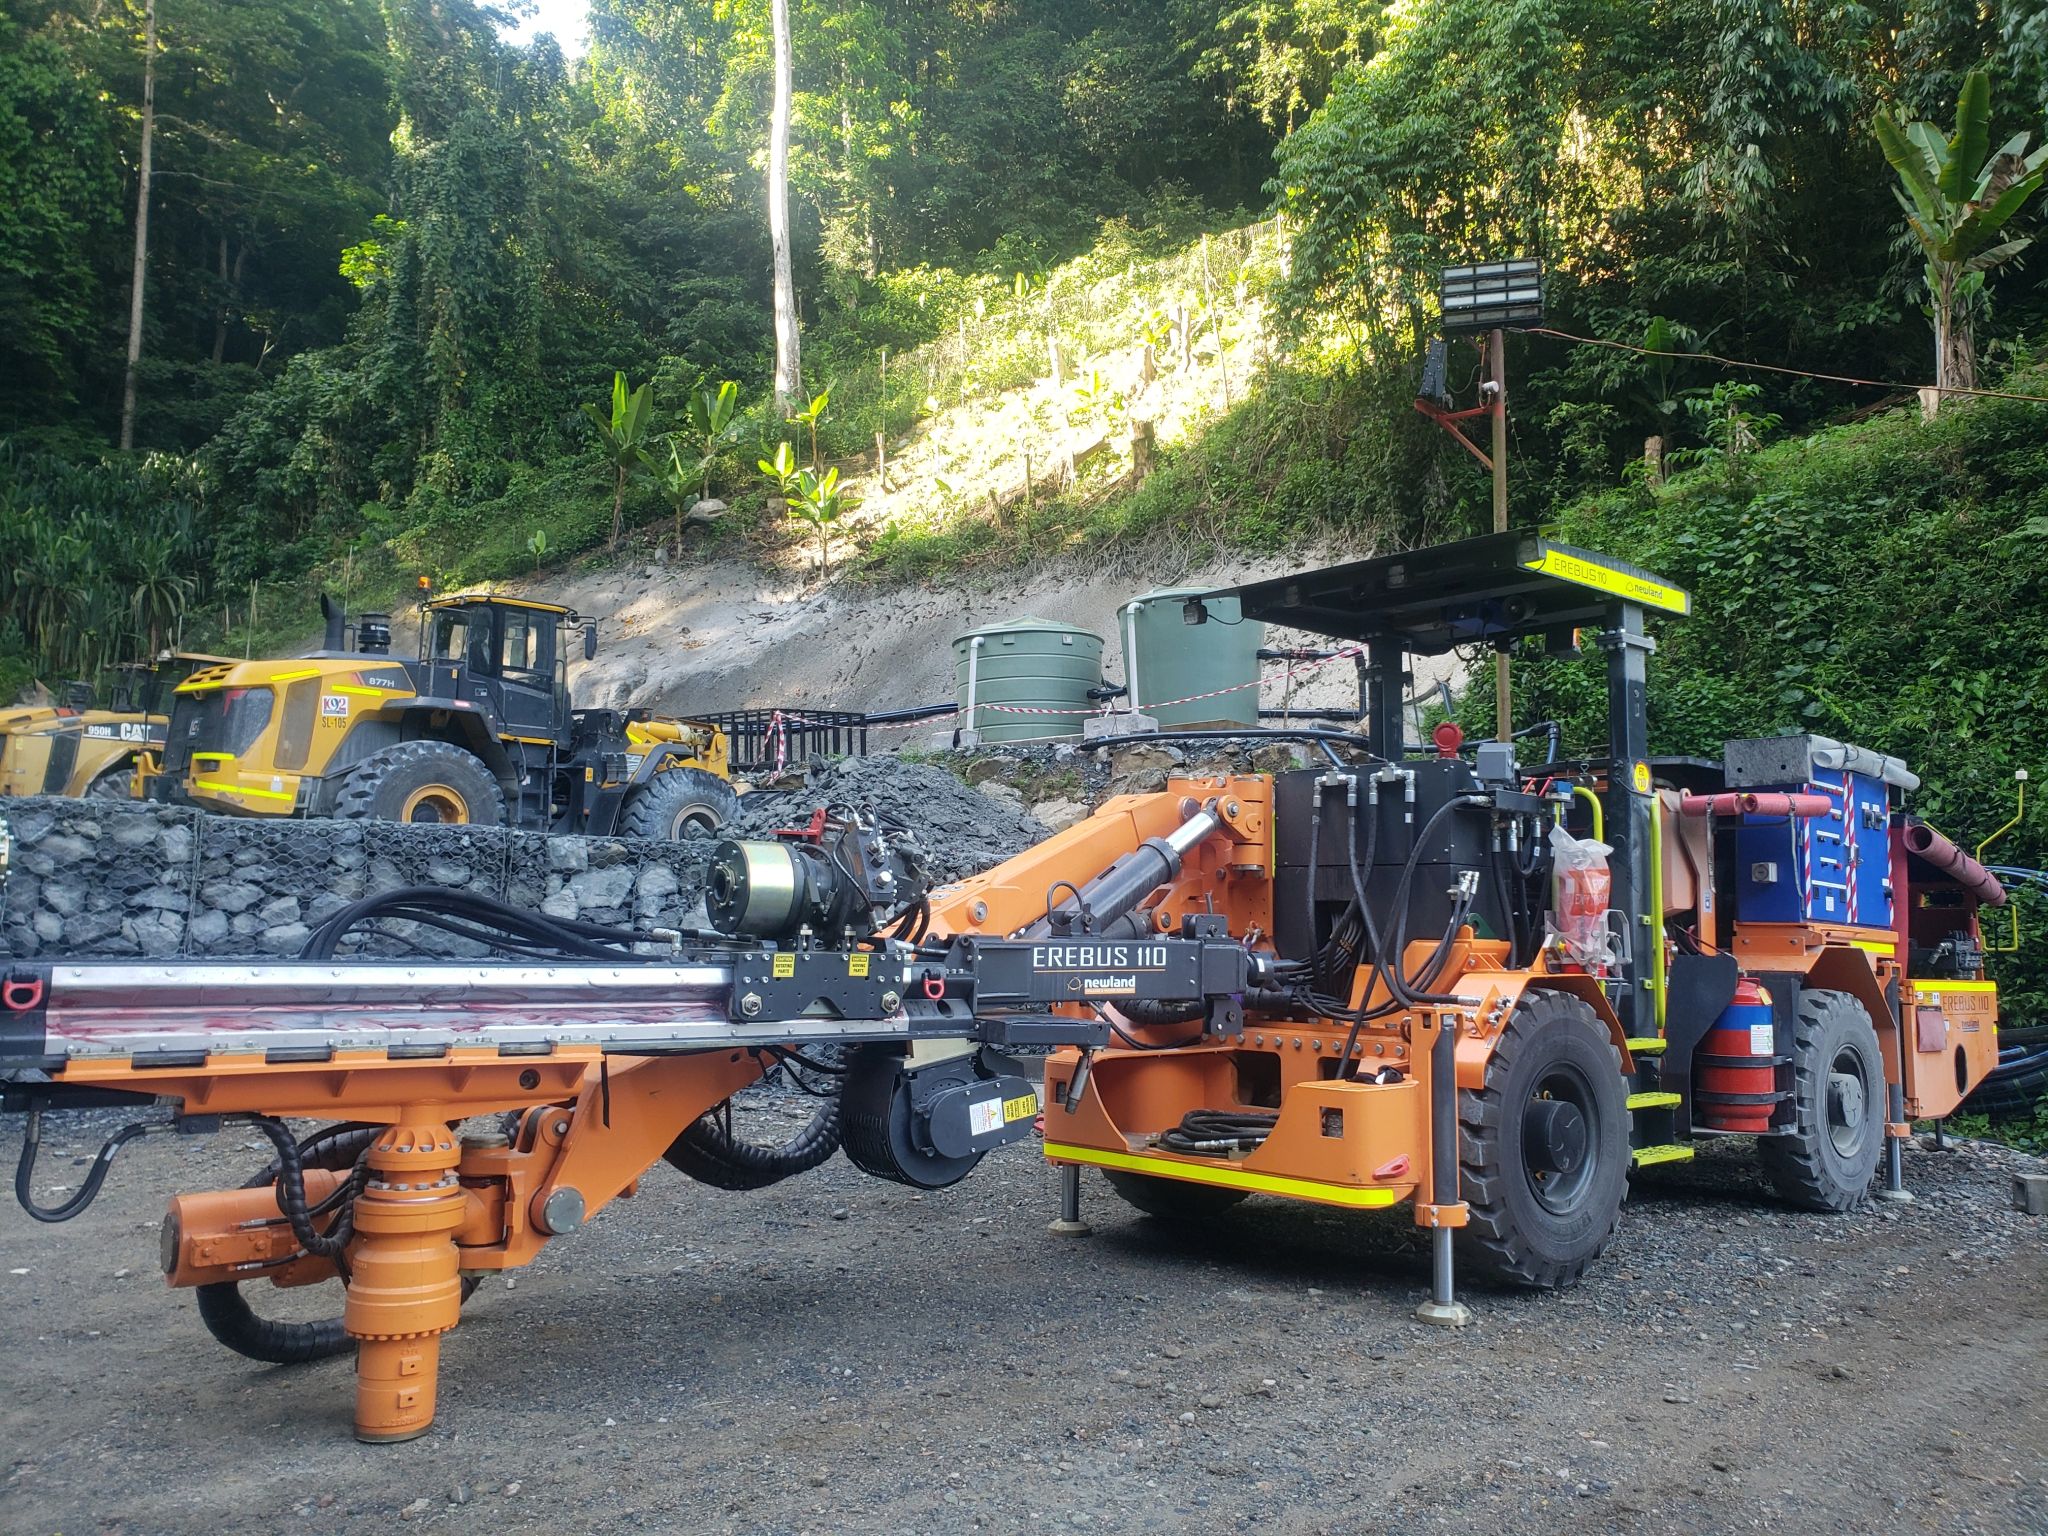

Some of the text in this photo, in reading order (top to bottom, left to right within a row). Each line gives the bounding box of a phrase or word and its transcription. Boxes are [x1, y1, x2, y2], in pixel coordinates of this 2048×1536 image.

[1554, 558, 1607, 585] EREBUS 110
[1634, 584, 1663, 599] newland
[368, 677, 395, 688] 877H
[323, 697, 347, 710] K92
[321, 716, 347, 728] SL-105
[87, 722, 152, 741] 950H CAT
[1033, 946, 1167, 967] EREBUS 110
[1084, 975, 1136, 988] newland
[1943, 995, 1975, 1011] EREBUS
[1978, 995, 1989, 1010] 110
